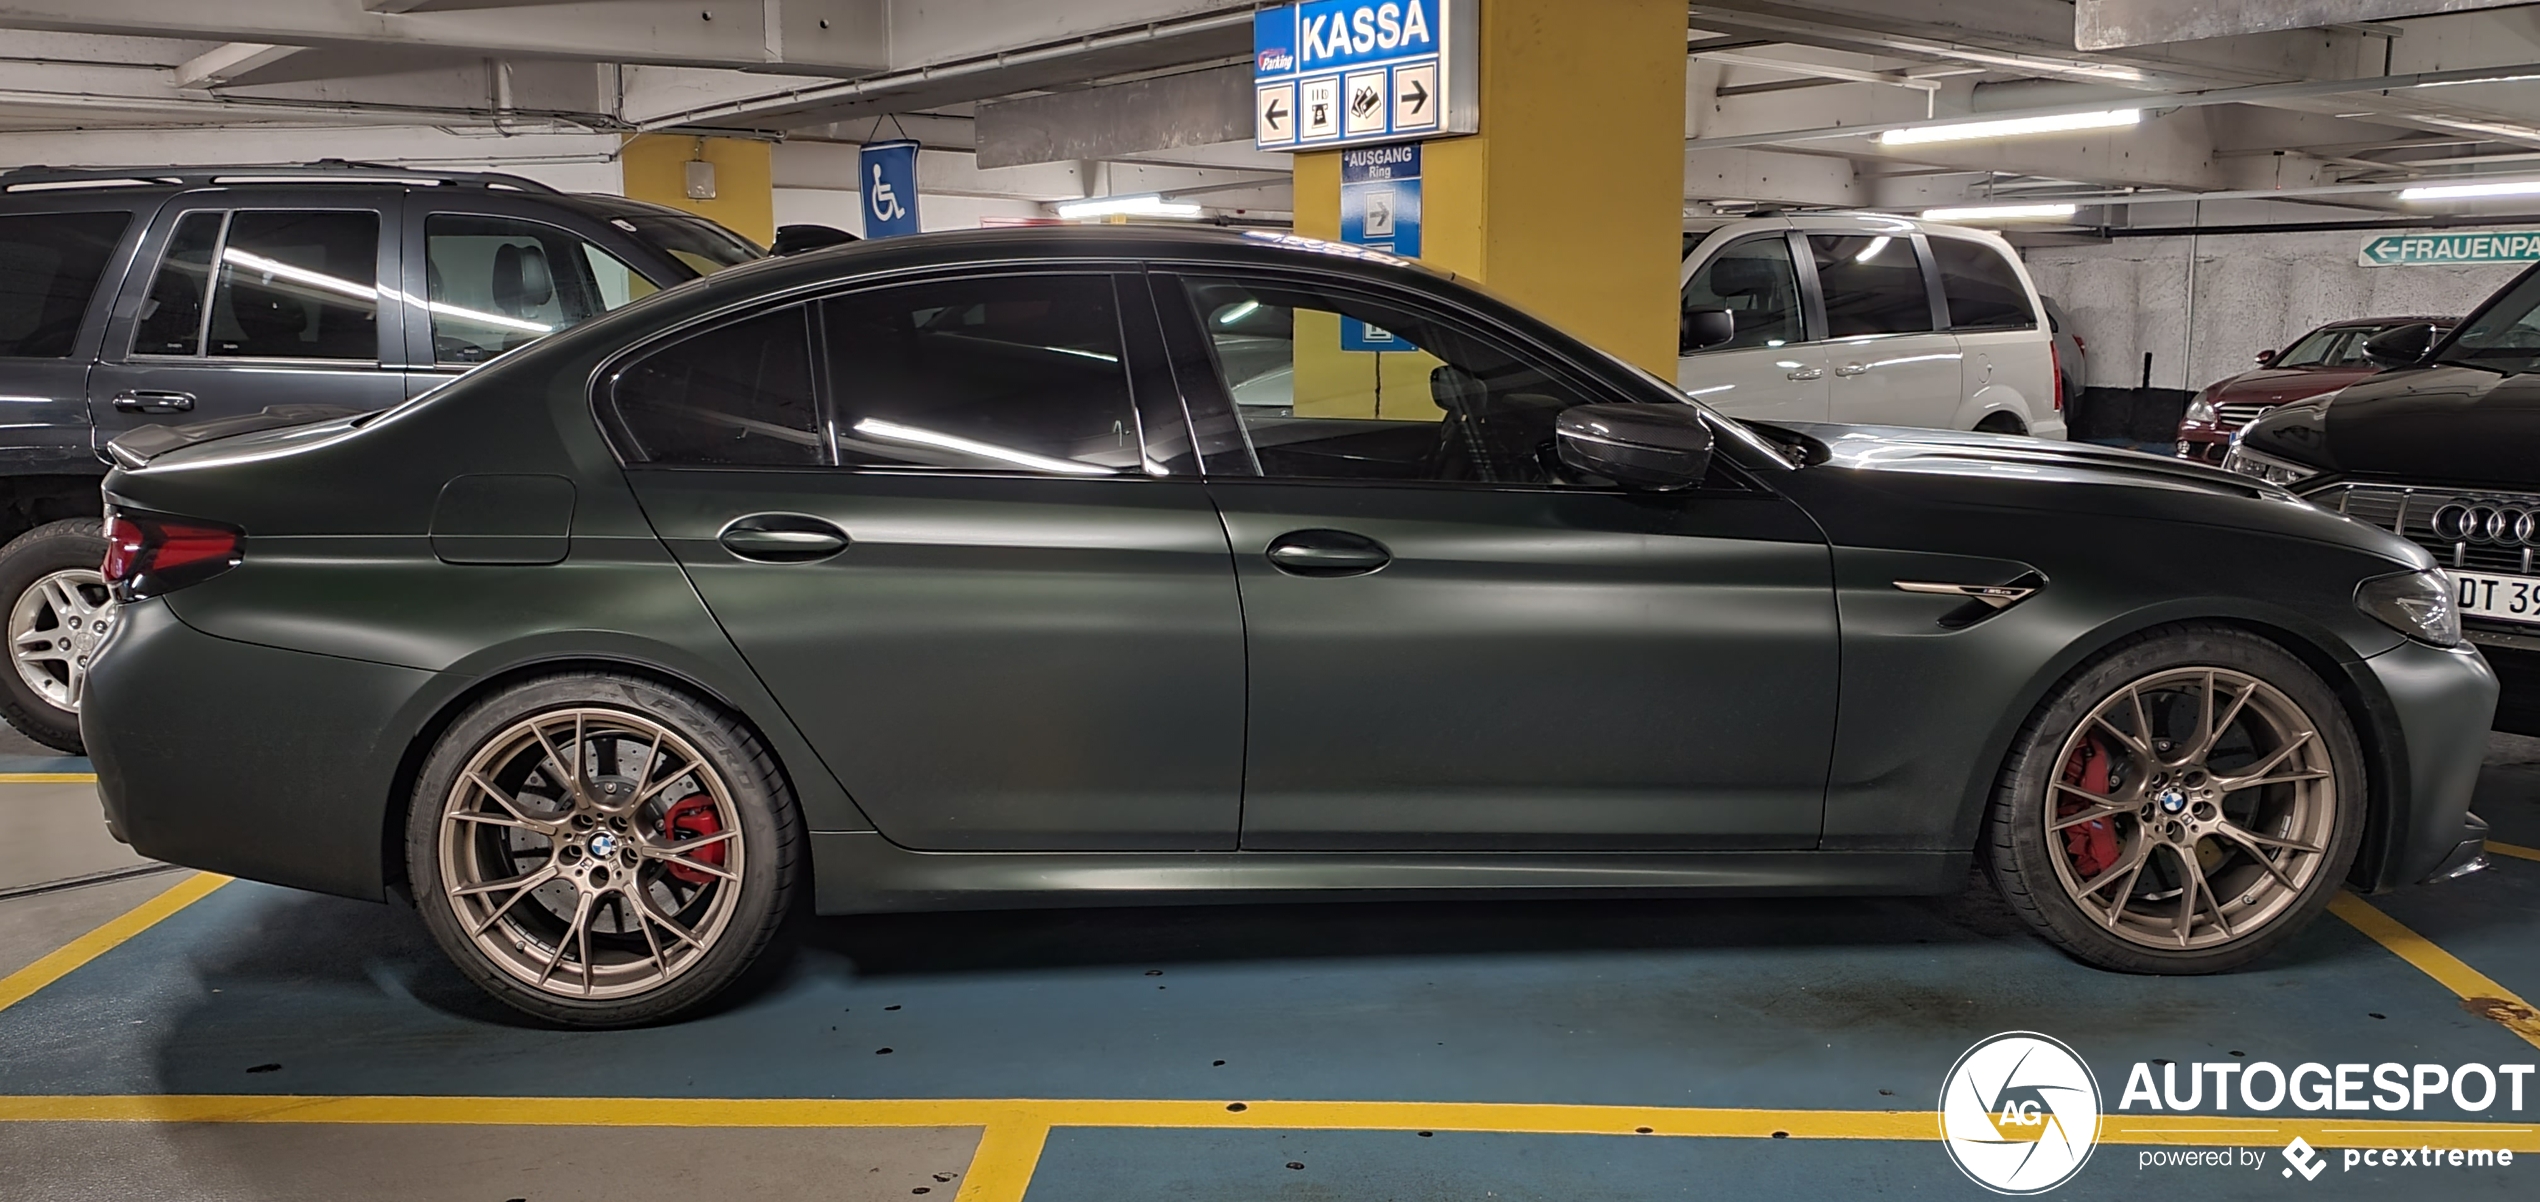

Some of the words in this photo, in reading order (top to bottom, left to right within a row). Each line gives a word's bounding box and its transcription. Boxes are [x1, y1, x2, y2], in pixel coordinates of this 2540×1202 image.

[1302, 0, 1430, 61] KASSA
[1261, 54, 1294, 71] Parking
[1349, 147, 1412, 167] AUSGANG
[1369, 166, 1391, 178] Ring
[2401, 236, 2540, 259] FRAUENPA
[2457, 577, 2499, 611] DT
